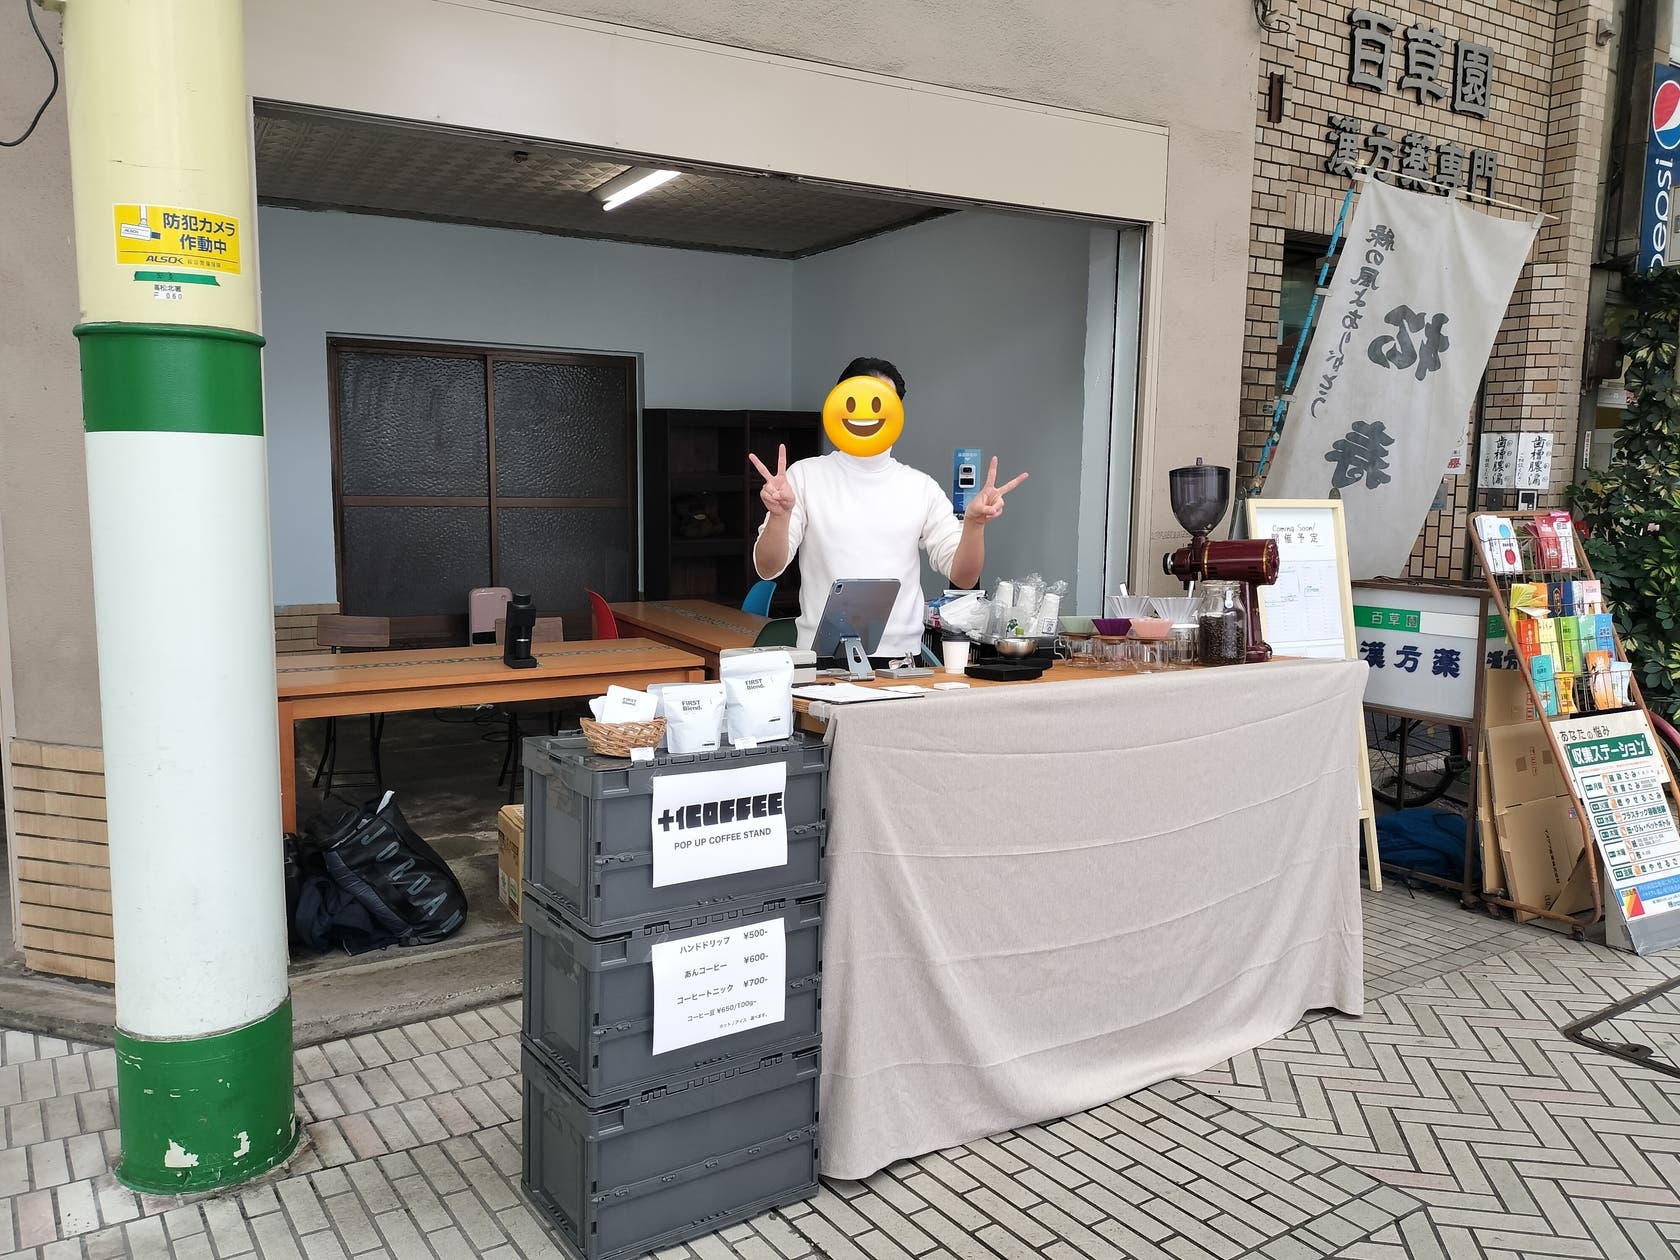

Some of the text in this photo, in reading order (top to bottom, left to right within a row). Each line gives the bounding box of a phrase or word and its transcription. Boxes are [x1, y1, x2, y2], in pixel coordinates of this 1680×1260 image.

[1348, 7, 1495, 118] 百草園
[1325, 115, 1498, 205] 漢方薬専門
[162, 212, 236, 237] 防犯カメラ
[179, 234, 227, 254] 作動中
[146, 255, 183, 264] ALSOK
[1272, 523, 1295, 533] Coming
[1371, 611, 1418, 628] 百草園
[1360, 640, 1461, 679] 漢方薬
[745, 678, 763, 686] FIRST
[1559, 725, 1610, 742] あなたの悩み
[1571, 740, 1646, 765] 収集ステーション
[674, 827, 772, 850] POP UP COFFEE STAND
[680, 928, 768, 954] ハンドドリップ ¥500-
[684, 952, 769, 979] あんコーヒー ¥600-
[677, 976, 769, 1005] コーヒートニック ¥700-
[687, 1009, 715, 1022] コーヒー豆
